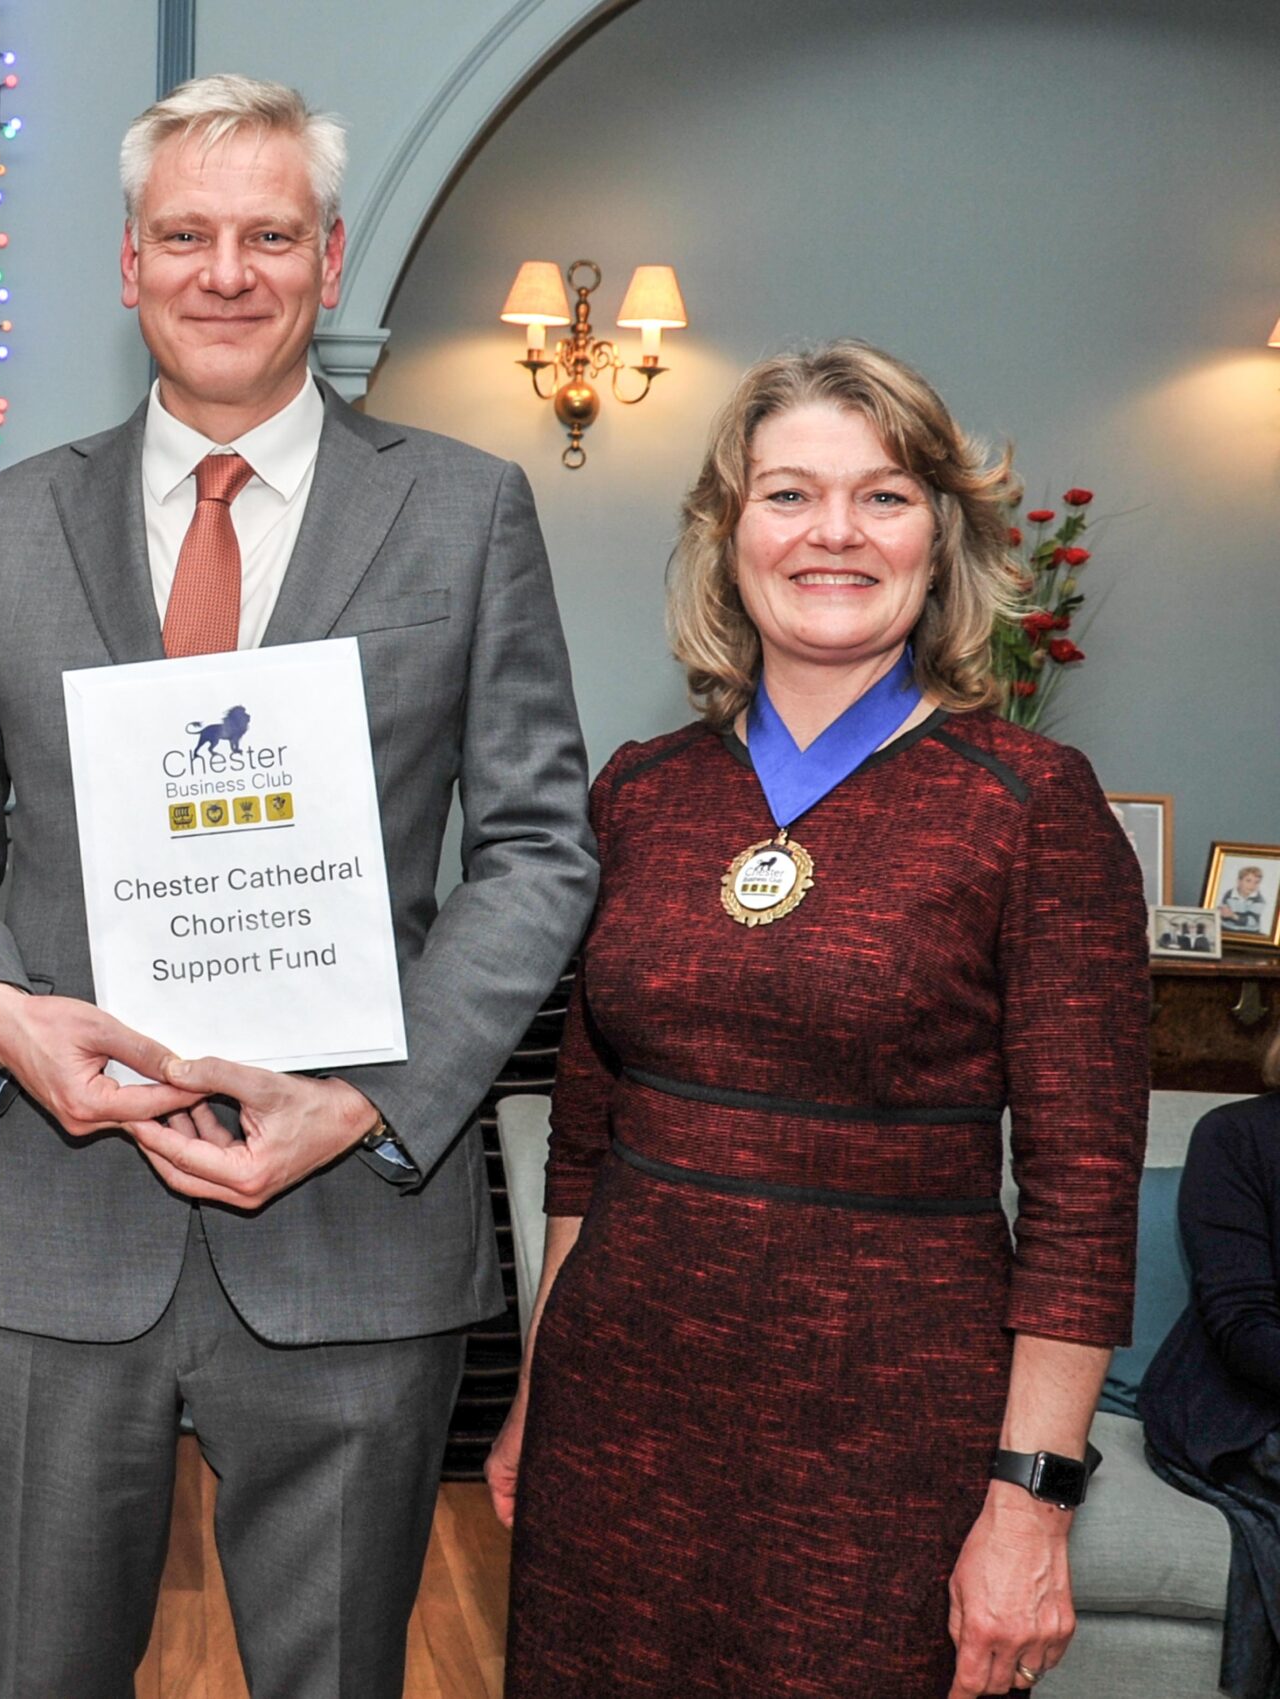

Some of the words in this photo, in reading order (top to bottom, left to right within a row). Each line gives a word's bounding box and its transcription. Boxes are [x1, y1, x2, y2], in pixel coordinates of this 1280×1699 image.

[163, 743, 288, 778] Chester
[166, 779, 246, 799] Business
[252, 771, 293, 790] Club
[114, 876, 219, 901] Chester
[228, 856, 363, 890] Cathedral
[170, 909, 312, 938] Choristers
[152, 953, 262, 983] Support
[269, 943, 337, 970] Fund
